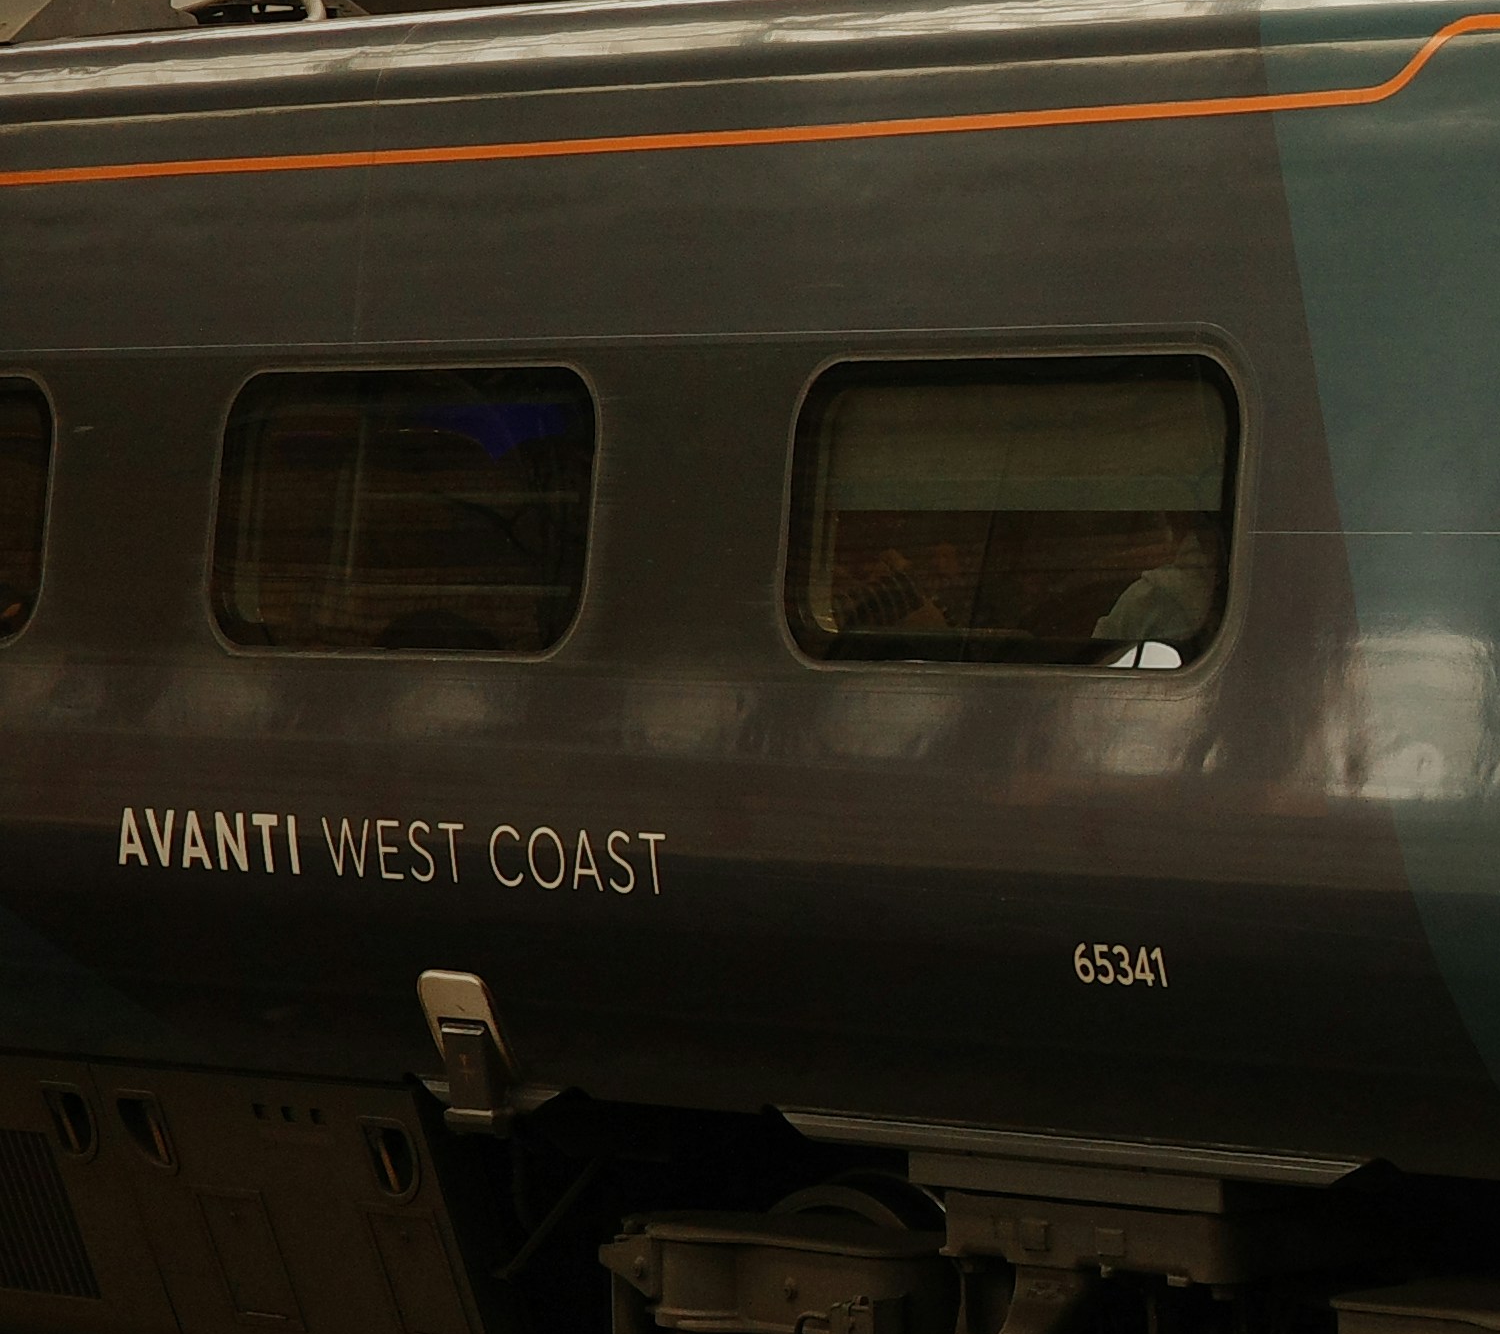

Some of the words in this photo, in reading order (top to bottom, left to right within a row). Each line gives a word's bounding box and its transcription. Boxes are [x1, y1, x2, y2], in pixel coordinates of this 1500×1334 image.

[118, 806, 300, 875] AVANTI
[321, 816, 464, 884] WEST
[489, 825, 667, 895] COAST
[1073, 942, 1168, 988] 65341
